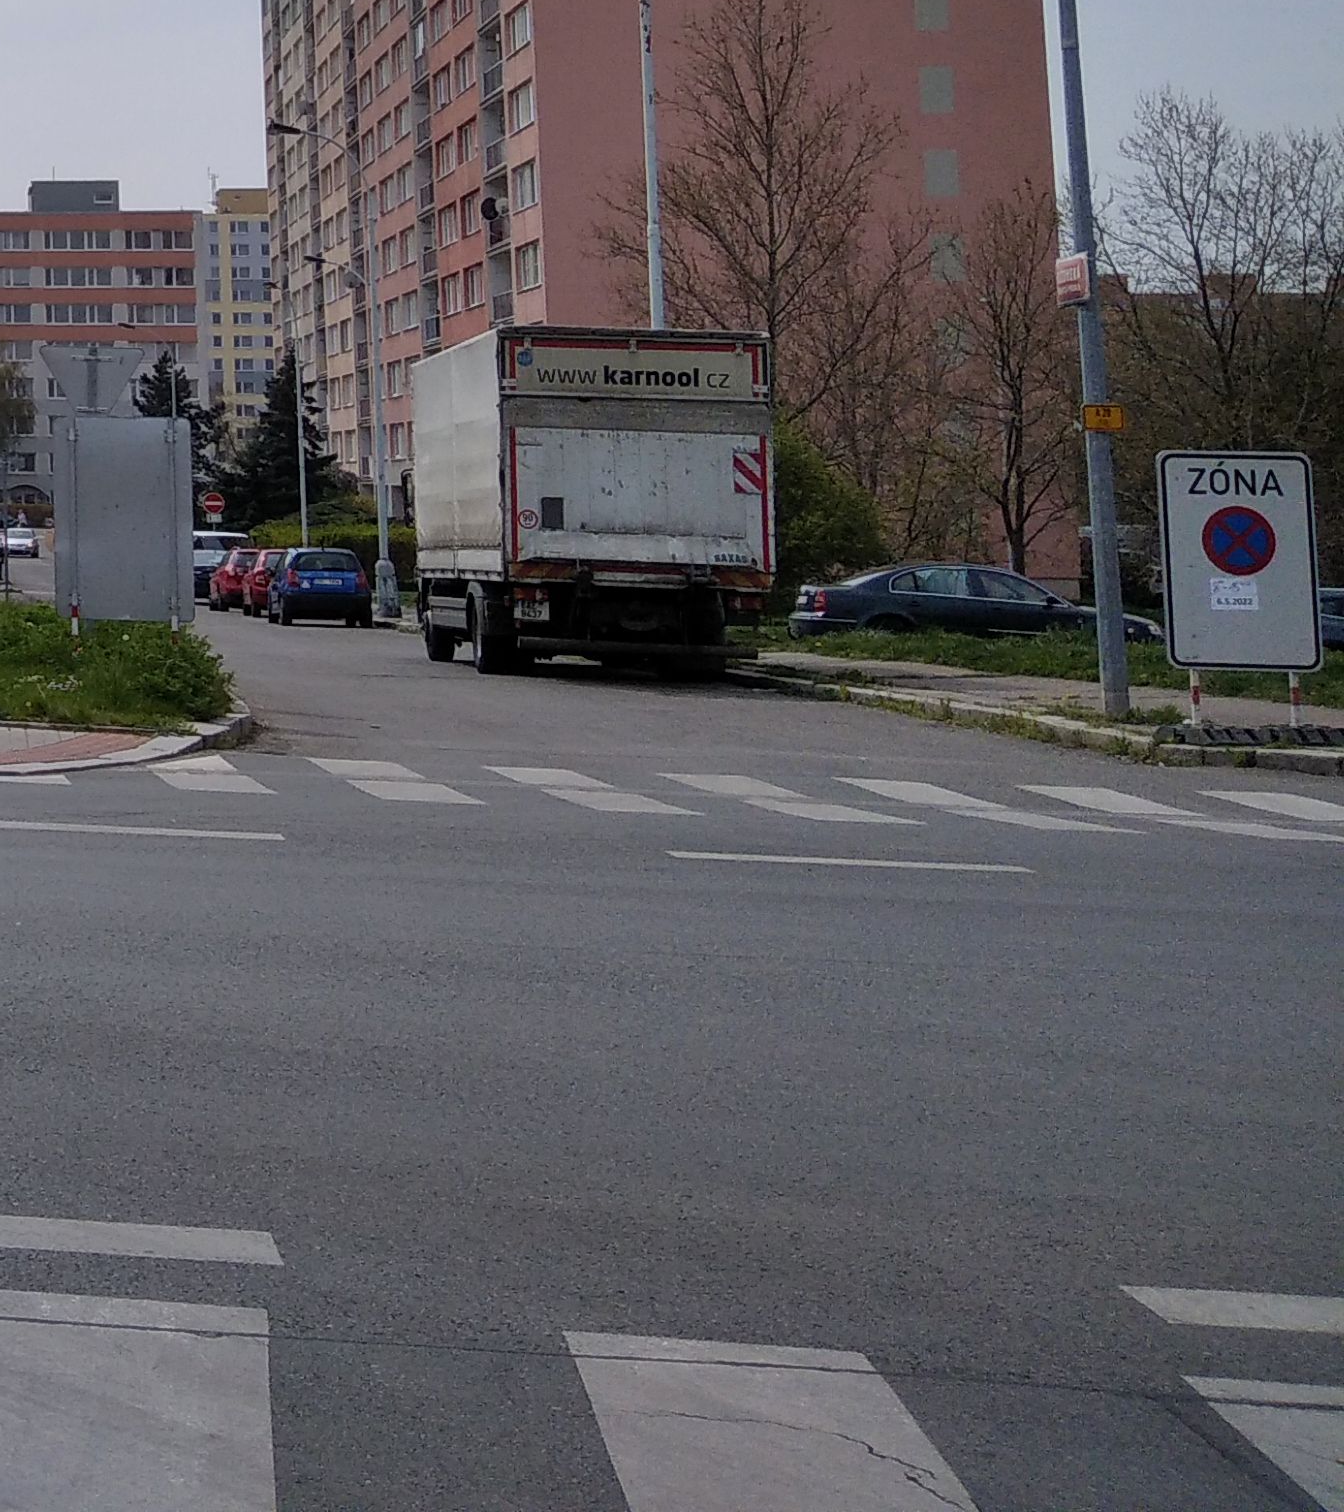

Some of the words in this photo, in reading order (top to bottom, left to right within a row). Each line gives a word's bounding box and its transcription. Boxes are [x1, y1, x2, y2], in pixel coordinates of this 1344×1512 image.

[537, 367, 597, 385] www
[603, 365, 700, 388] karnool
[706, 372, 731, 389] cz
[1187, 461, 1284, 497] ZÓNA
